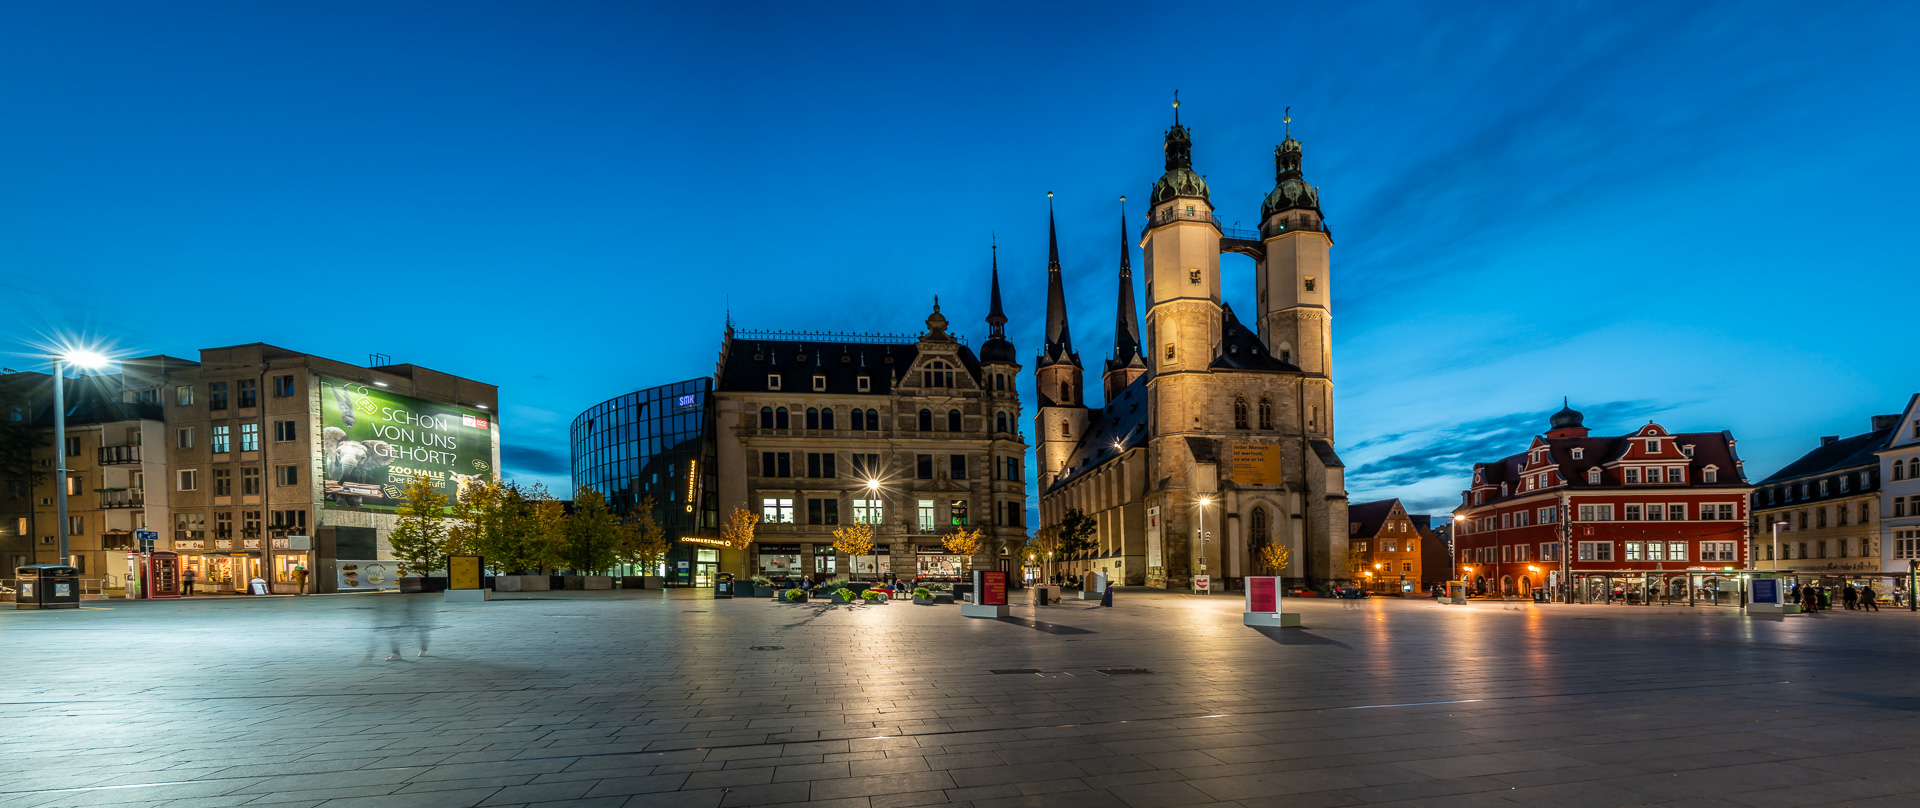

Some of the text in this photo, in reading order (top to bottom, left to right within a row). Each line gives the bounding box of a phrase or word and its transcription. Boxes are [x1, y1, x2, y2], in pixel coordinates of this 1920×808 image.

[679, 394, 695, 406] SMK
[382, 407, 447, 432] SCHON
[372, 423, 457, 450] VON UNS
[374, 441, 457, 467] GEHÖRT?
[388, 465, 445, 479] ZOO HALLE
[388, 475, 405, 484] Der
[687, 459, 696, 503] COMMERZBANK
[681, 536, 725, 546] COMMERZBANK
